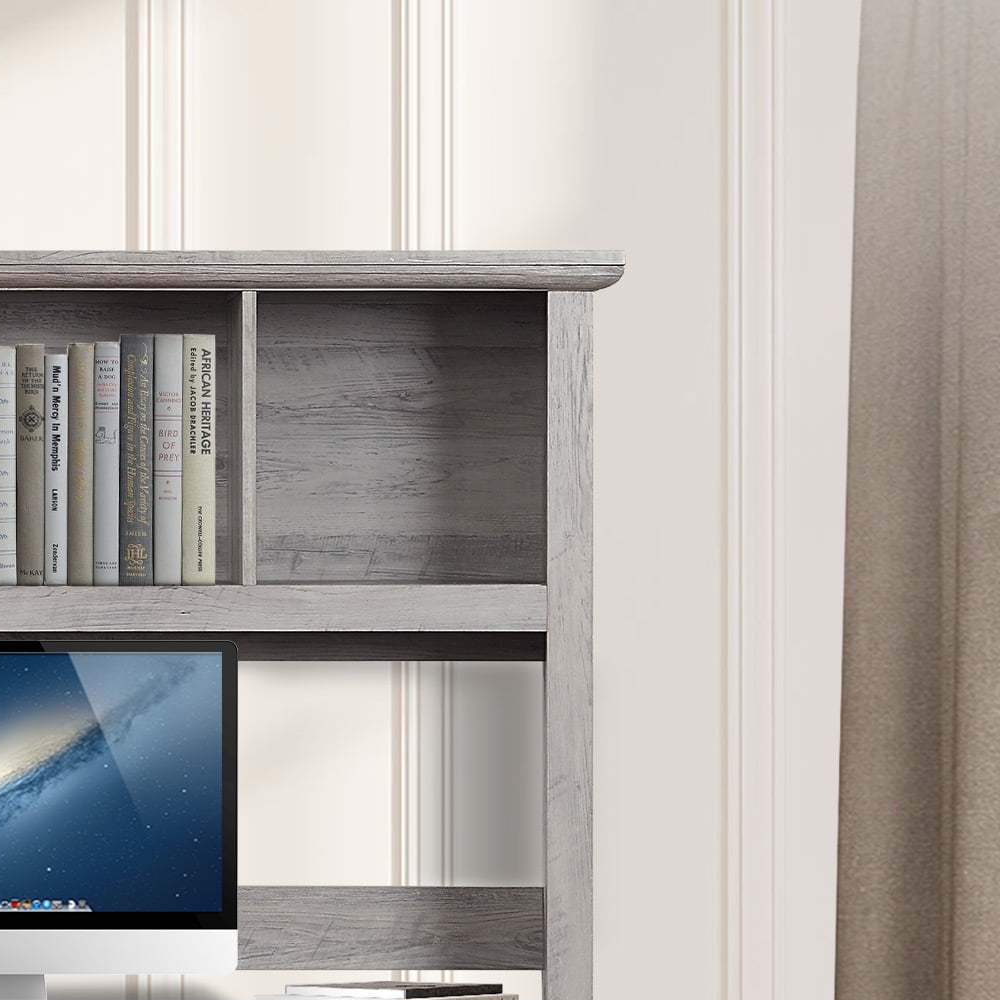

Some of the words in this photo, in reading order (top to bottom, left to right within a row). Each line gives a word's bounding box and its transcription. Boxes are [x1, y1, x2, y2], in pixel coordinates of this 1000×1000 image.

[190, 347, 198, 372] Edited
[51, 365, 62, 393] Mud'n
[188, 374, 198, 384] by
[201, 349, 212, 398] AFRICAN
[50, 395, 62, 420] Mercy
[51, 423, 61, 432] In
[158, 429, 179, 438] BIRD
[201, 401, 212, 455] HERITAGE
[49, 434, 61, 472] Memphis
[158, 453, 180, 462] PREY
[162, 441, 176, 450] OF
